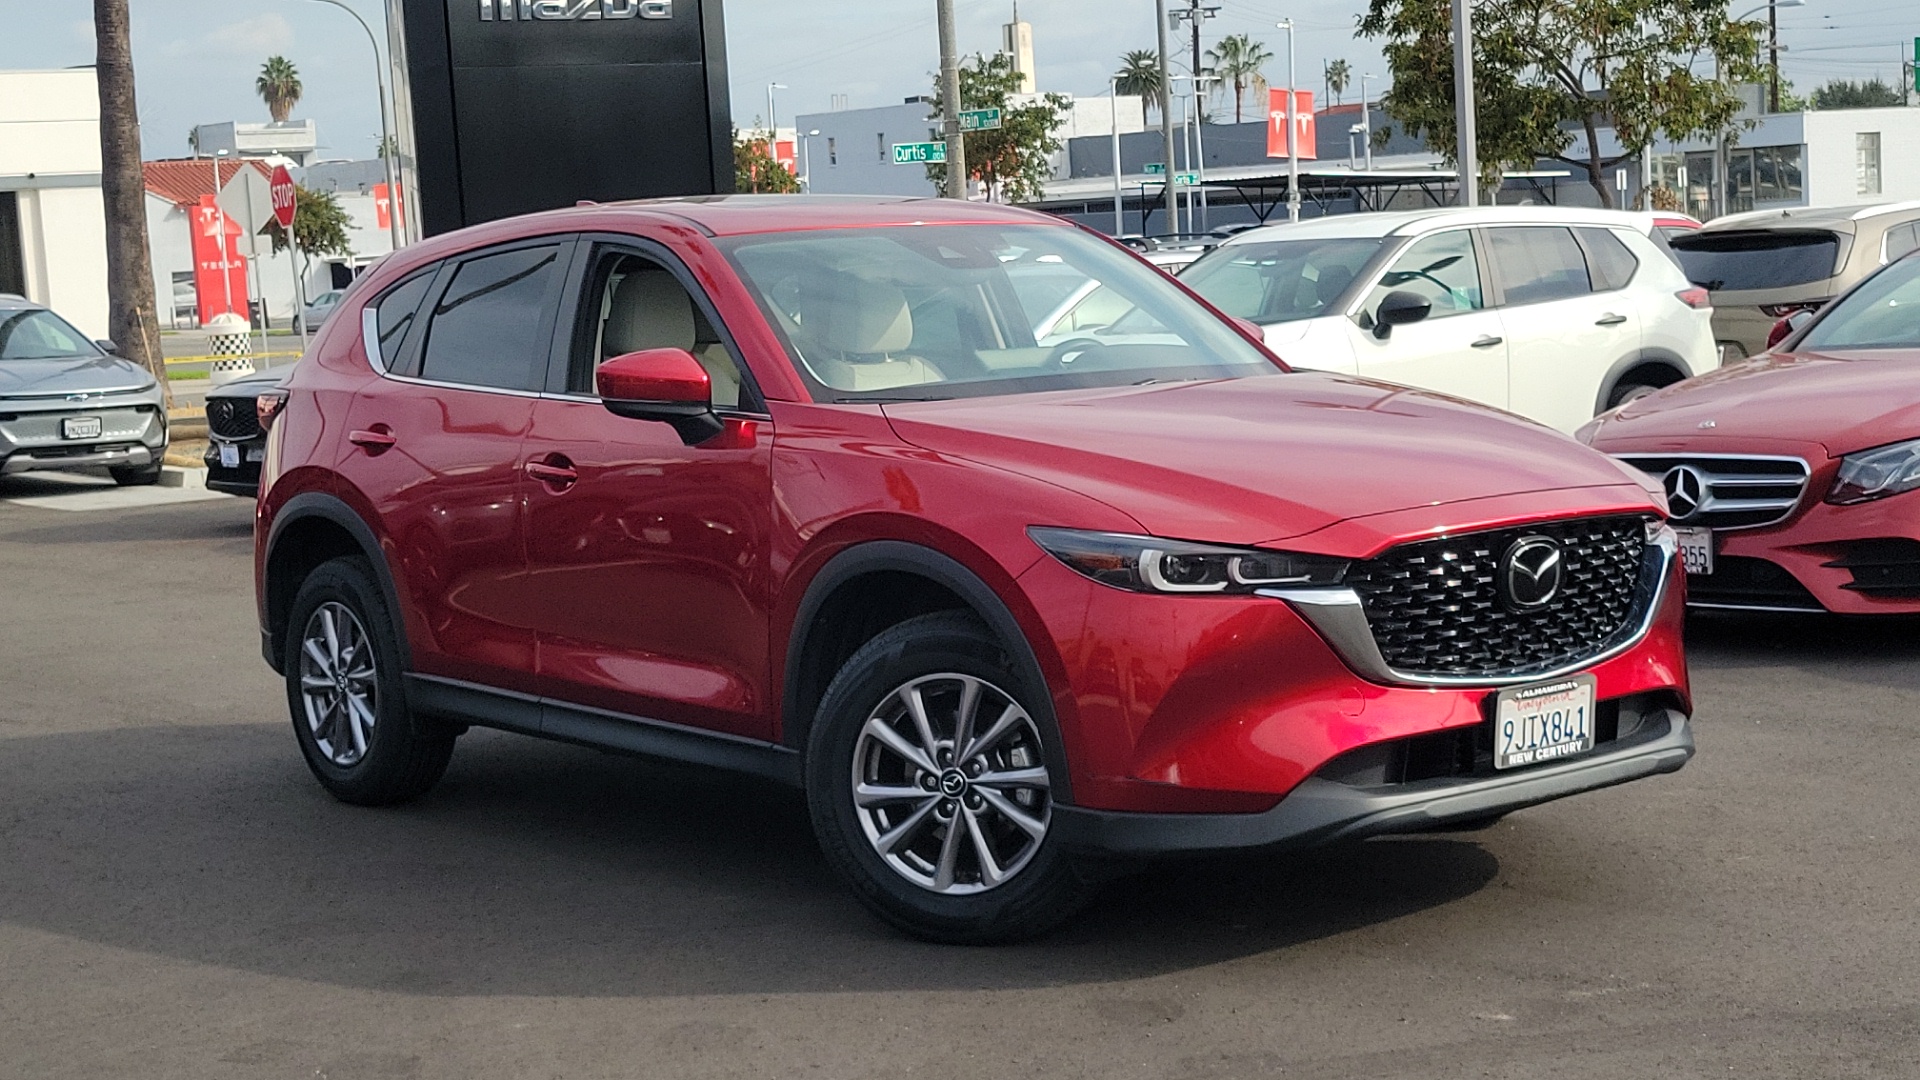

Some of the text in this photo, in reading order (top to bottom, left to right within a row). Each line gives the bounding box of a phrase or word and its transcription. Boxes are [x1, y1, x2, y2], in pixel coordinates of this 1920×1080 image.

[959, 113, 979, 129] Main
[895, 145, 927, 162] Curtis
[272, 183, 294, 209] STOP
[201, 260, 242, 270] TESLA
[1522, 681, 1573, 698] ALHAMBRA
[1503, 705, 1586, 754] 9JIX841
[1509, 740, 1583, 765] NEW CENTURY
